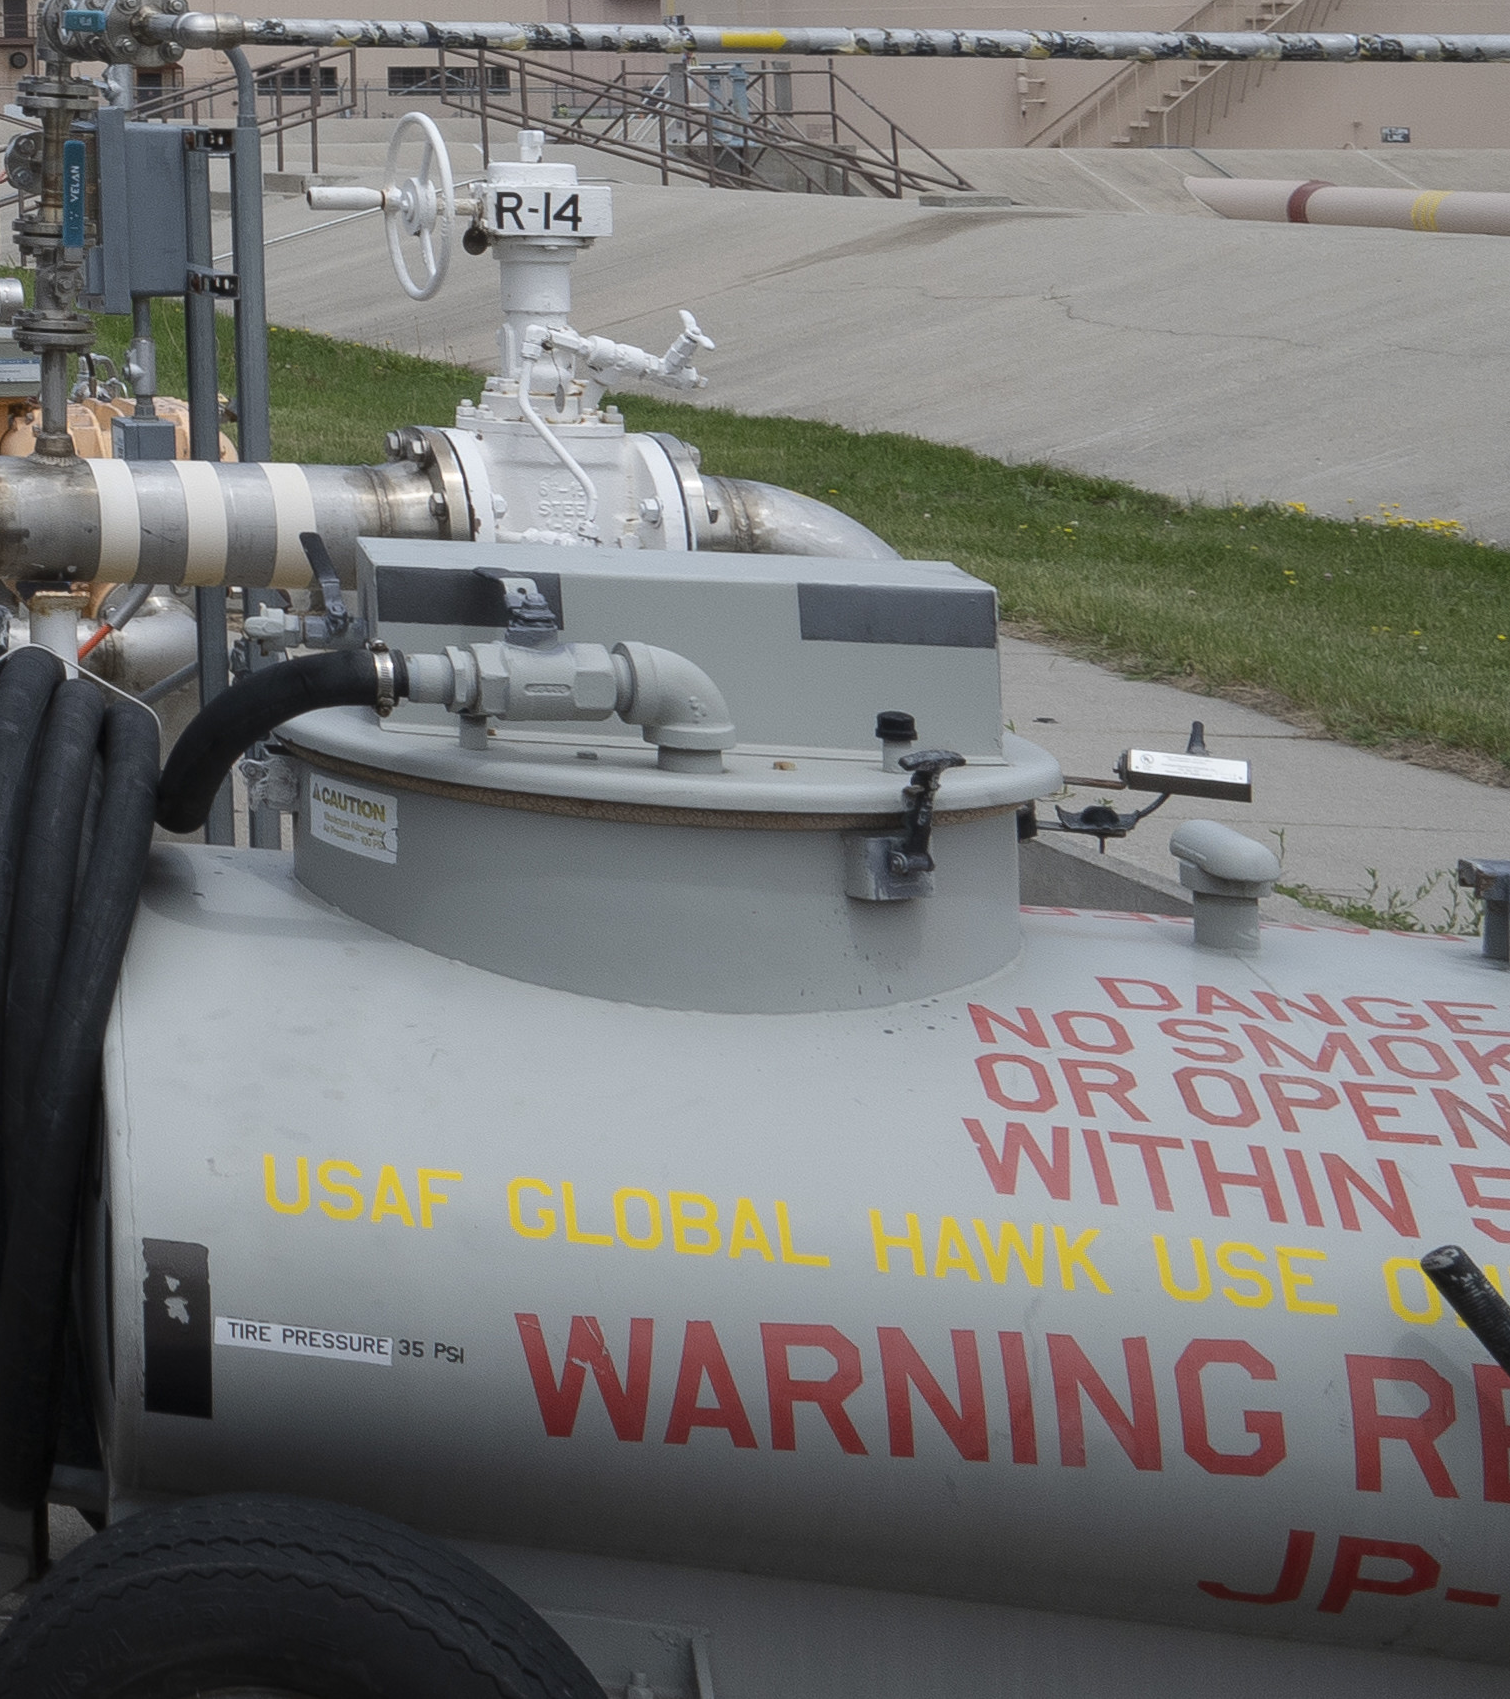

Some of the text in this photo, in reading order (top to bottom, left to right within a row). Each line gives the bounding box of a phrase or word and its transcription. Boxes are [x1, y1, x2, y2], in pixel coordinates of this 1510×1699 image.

[69, 165, 81, 203] VELAN
[495, 192, 582, 232] R-14
[321, 786, 386, 823] CAUTION
[967, 1002, 1135, 1055] NO
[973, 1052, 1152, 1123] OR
[961, 1116, 1421, 1239] WITHIN
[263, 1152, 464, 1229] USAF
[507, 1175, 831, 1268] GLOBAL
[868, 1207, 1113, 1295] HAWK
[1152, 1232, 1339, 1317] USE
[227, 1321, 464, 1364] TIRE PRESSURE 35 PSI
[514, 1310, 1288, 1477] WARNING
